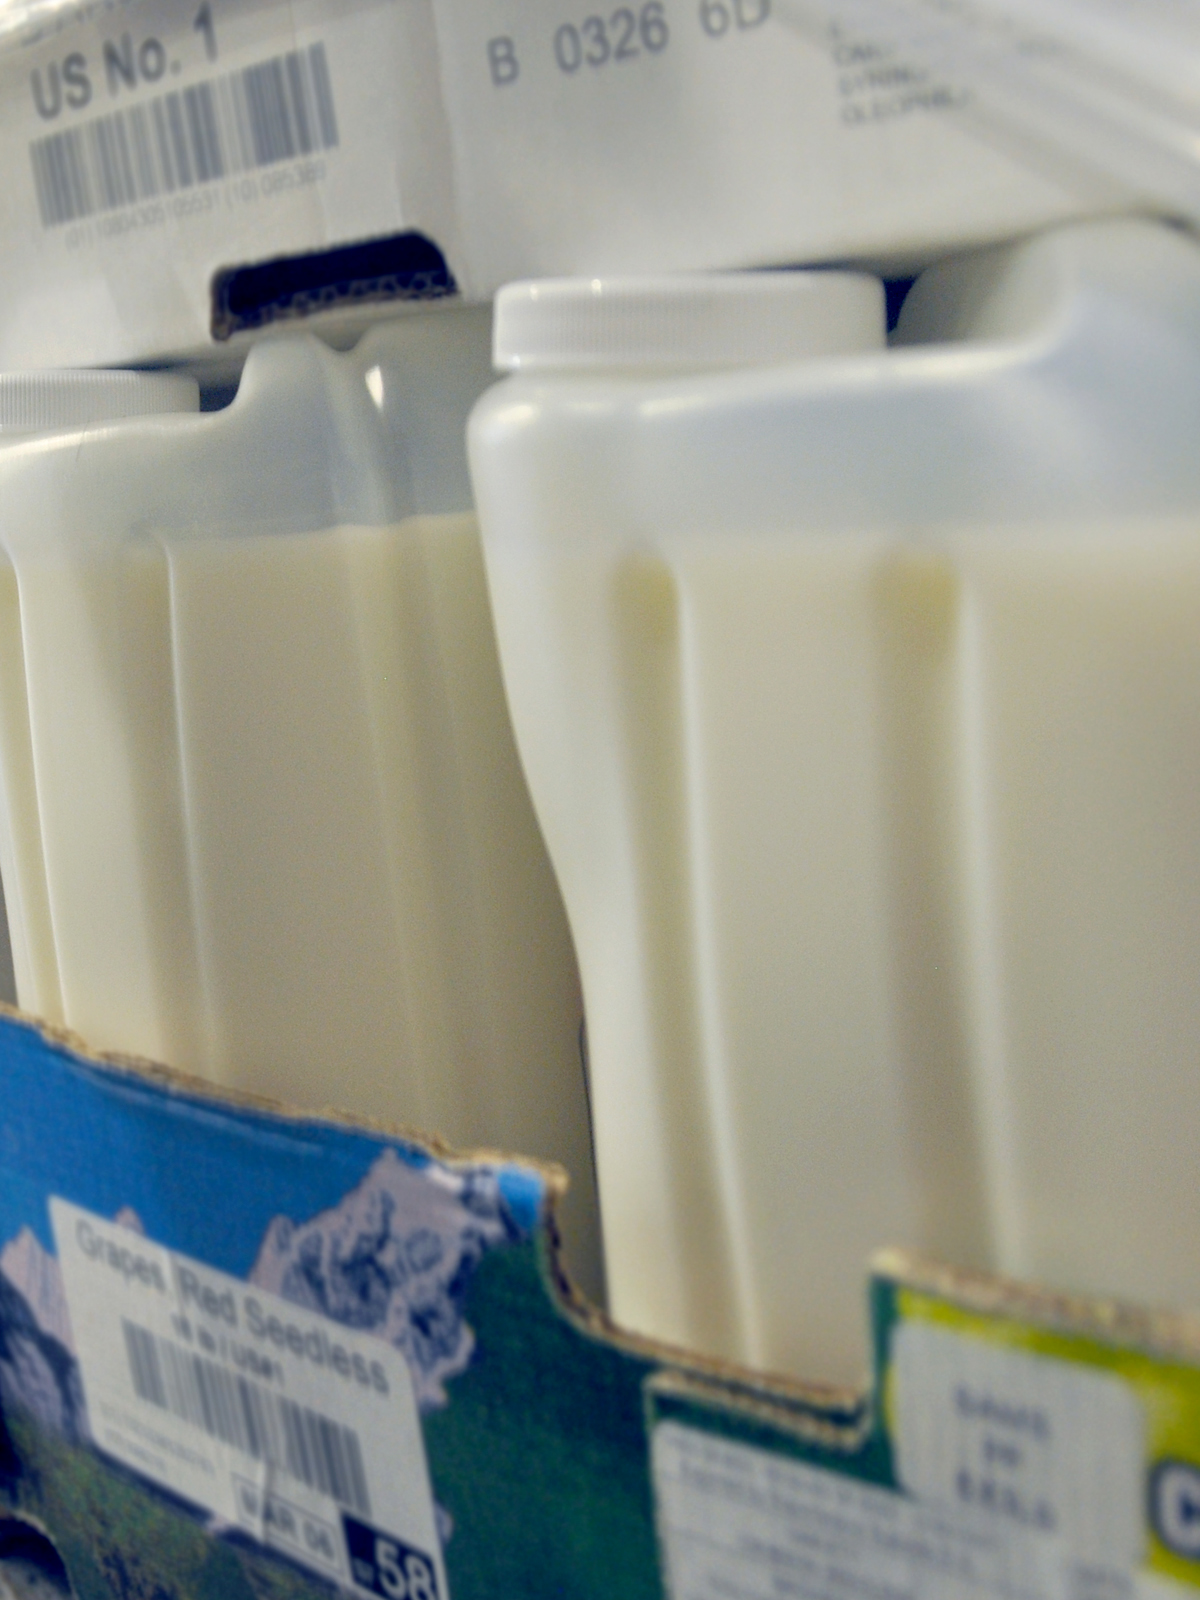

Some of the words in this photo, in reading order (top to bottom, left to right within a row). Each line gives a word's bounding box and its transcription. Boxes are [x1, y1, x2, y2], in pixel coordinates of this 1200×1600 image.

[30, 52, 93, 122] US
[102, 31, 183, 98] No.
[192, 1, 219, 64] 1
[486, 34, 520, 87] B
[553, 0, 671, 76] 0326
[75, 1217, 167, 1294] Grapes
[177, 1264, 238, 1329] Red
[243, 1295, 391, 1397] Seedless
